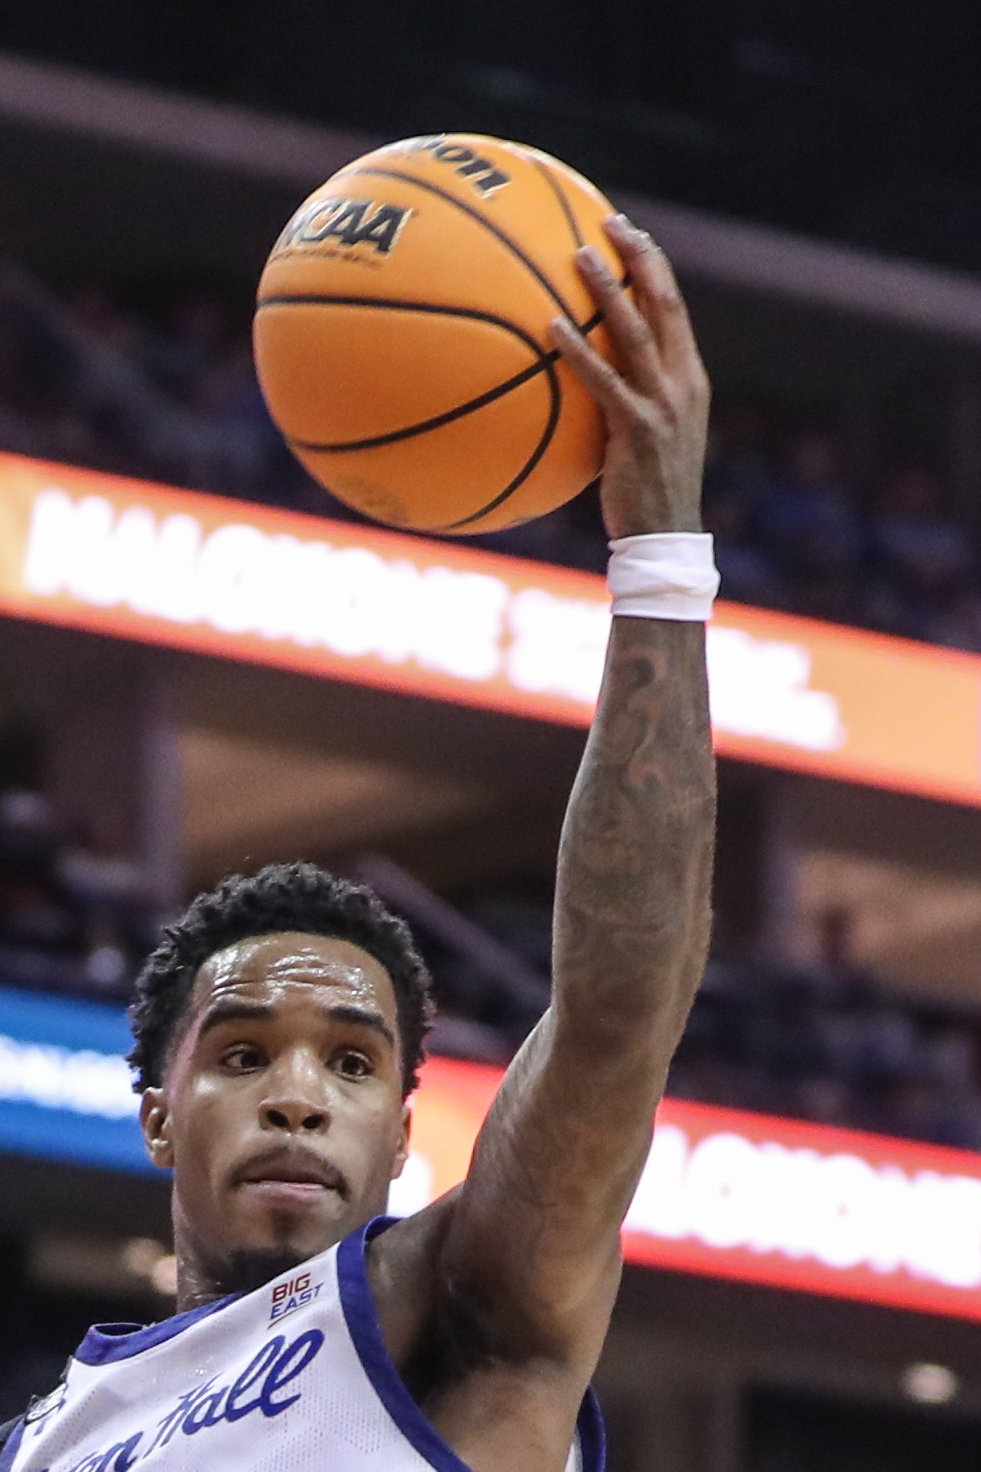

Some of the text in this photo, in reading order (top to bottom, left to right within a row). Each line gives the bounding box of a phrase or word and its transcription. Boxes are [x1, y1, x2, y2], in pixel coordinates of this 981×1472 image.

[269, 1281, 325, 1321] EAST
[271, 1272, 312, 1304] BIG
[141, 1328, 325, 1460] Hall
